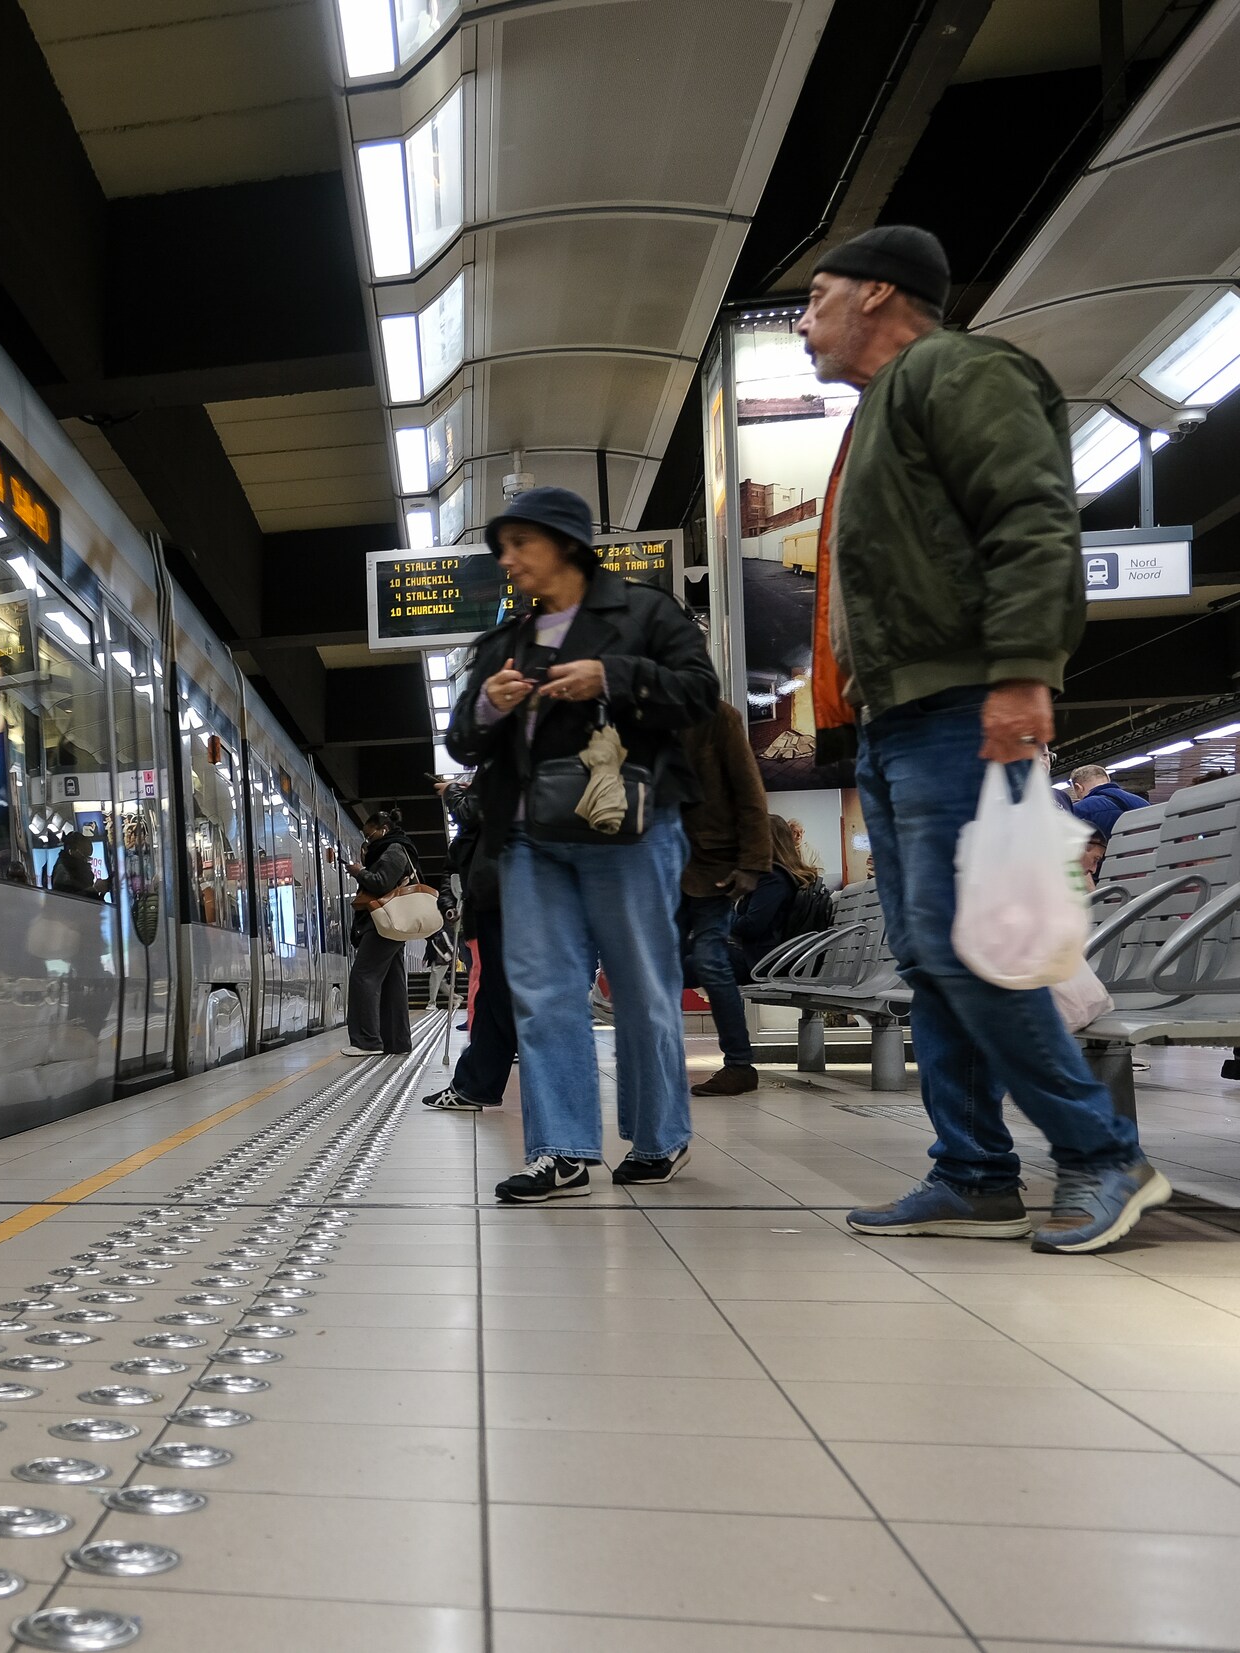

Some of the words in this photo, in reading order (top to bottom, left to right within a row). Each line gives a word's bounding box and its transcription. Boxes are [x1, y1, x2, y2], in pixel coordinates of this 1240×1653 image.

[642, 544, 664, 554] TRAM
[395, 563, 400, 572] 4
[405, 561, 436, 571] STALLE
[626, 561, 648, 570] TRAM
[653, 560, 664, 568] 10
[1130, 558, 1156, 567] Nord
[1128, 570, 1161, 580] Noord
[389, 578, 400, 587] 10
[406, 575, 453, 586] CHURCHILL
[395, 593, 401, 602] 4
[406, 590, 438, 601] STALLE
[507, 585, 513, 594] 8
[390, 608, 401, 617] 10
[406, 604, 454, 615] CHURCHILL
[503, 600, 514, 609] 13
